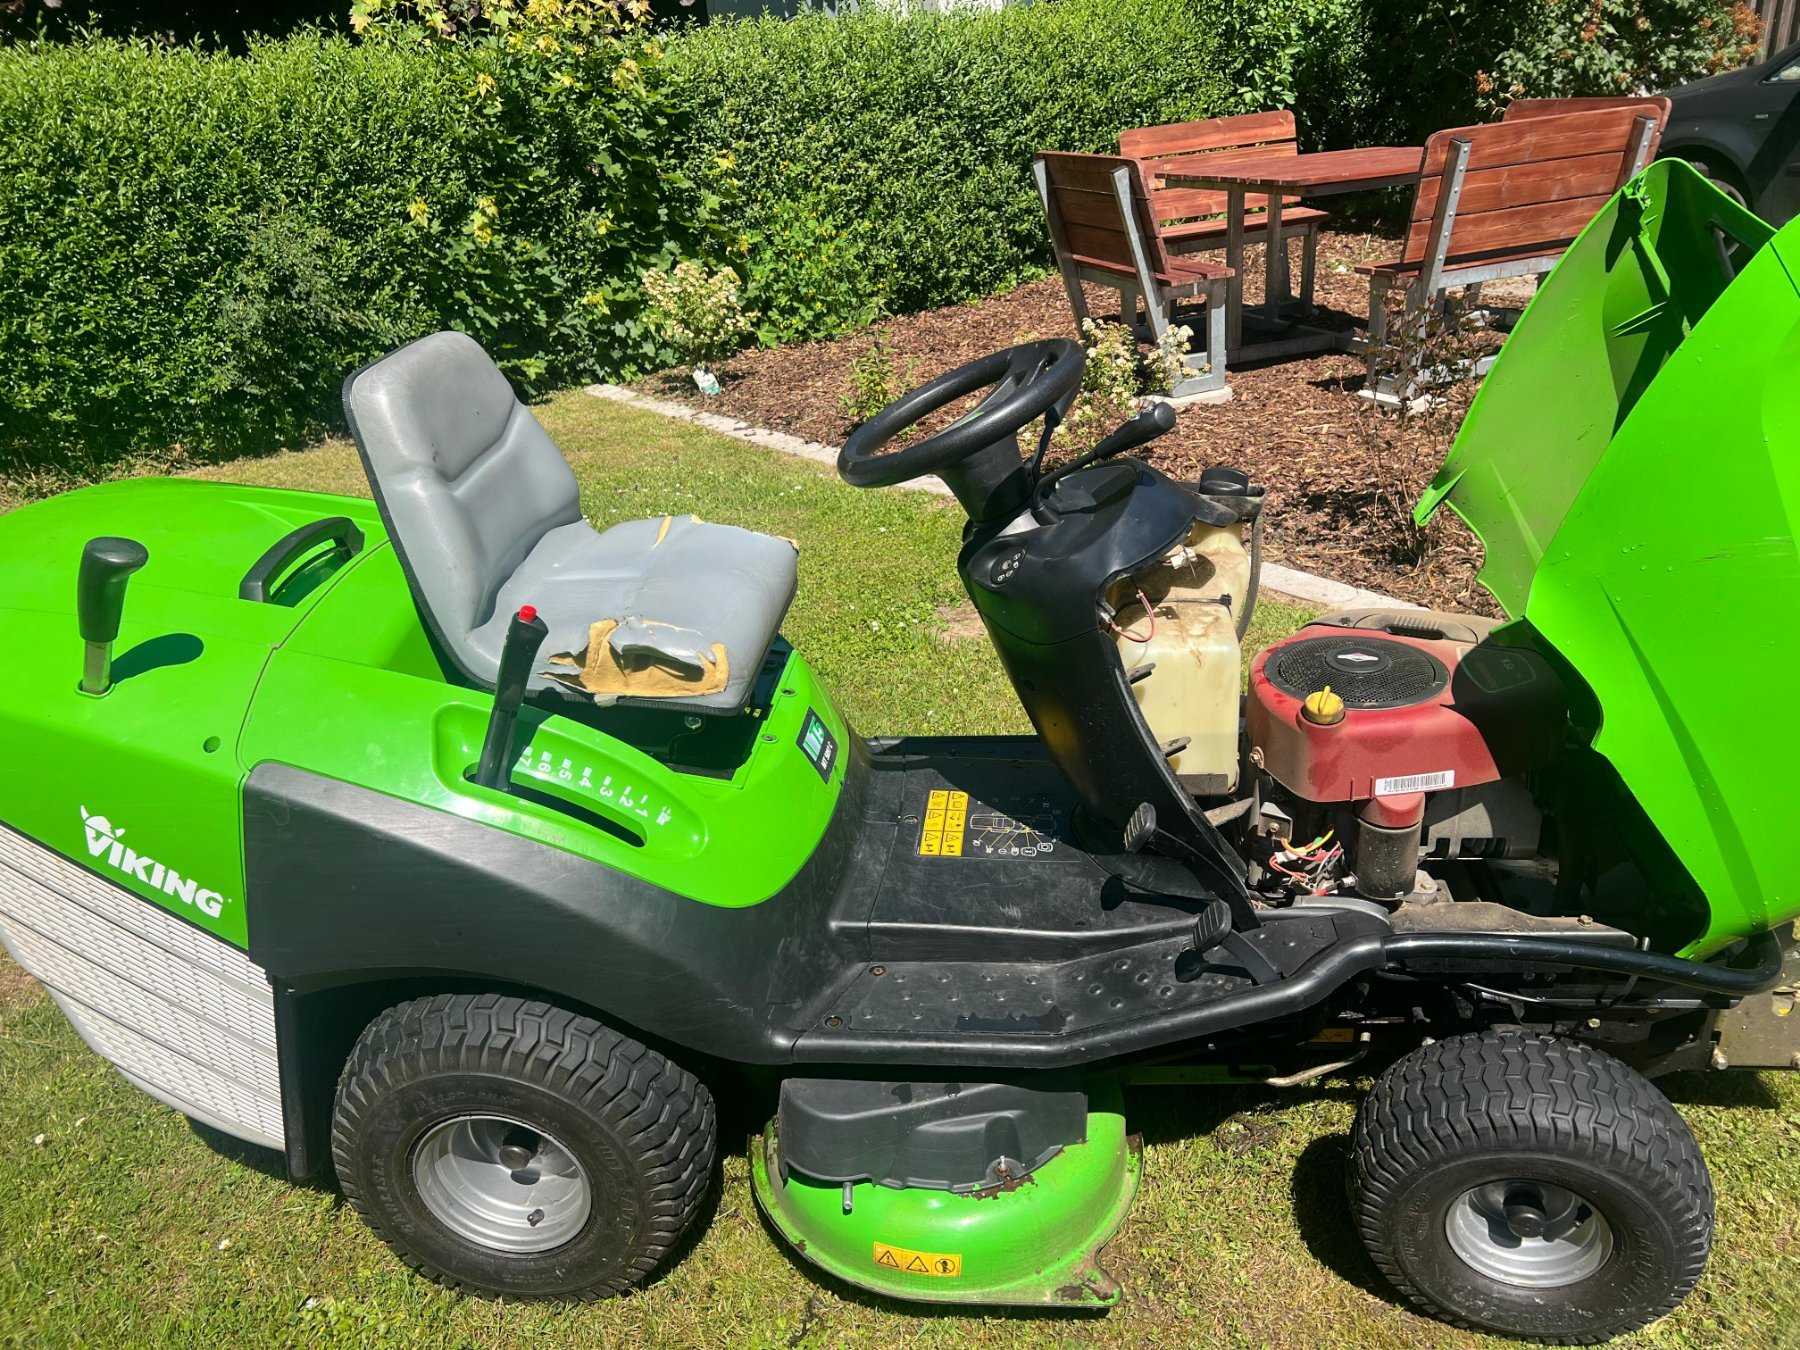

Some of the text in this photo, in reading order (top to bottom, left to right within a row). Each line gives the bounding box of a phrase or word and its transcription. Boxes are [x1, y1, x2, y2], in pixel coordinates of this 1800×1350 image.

[538, 762, 550, 772] 6
[559, 769, 573, 781] 5
[578, 777, 592, 788] 4
[600, 786, 613, 797] 3
[619, 795, 634, 808] 2
[635, 808, 649, 817] 1
[85, 825, 224, 919] VIKING
